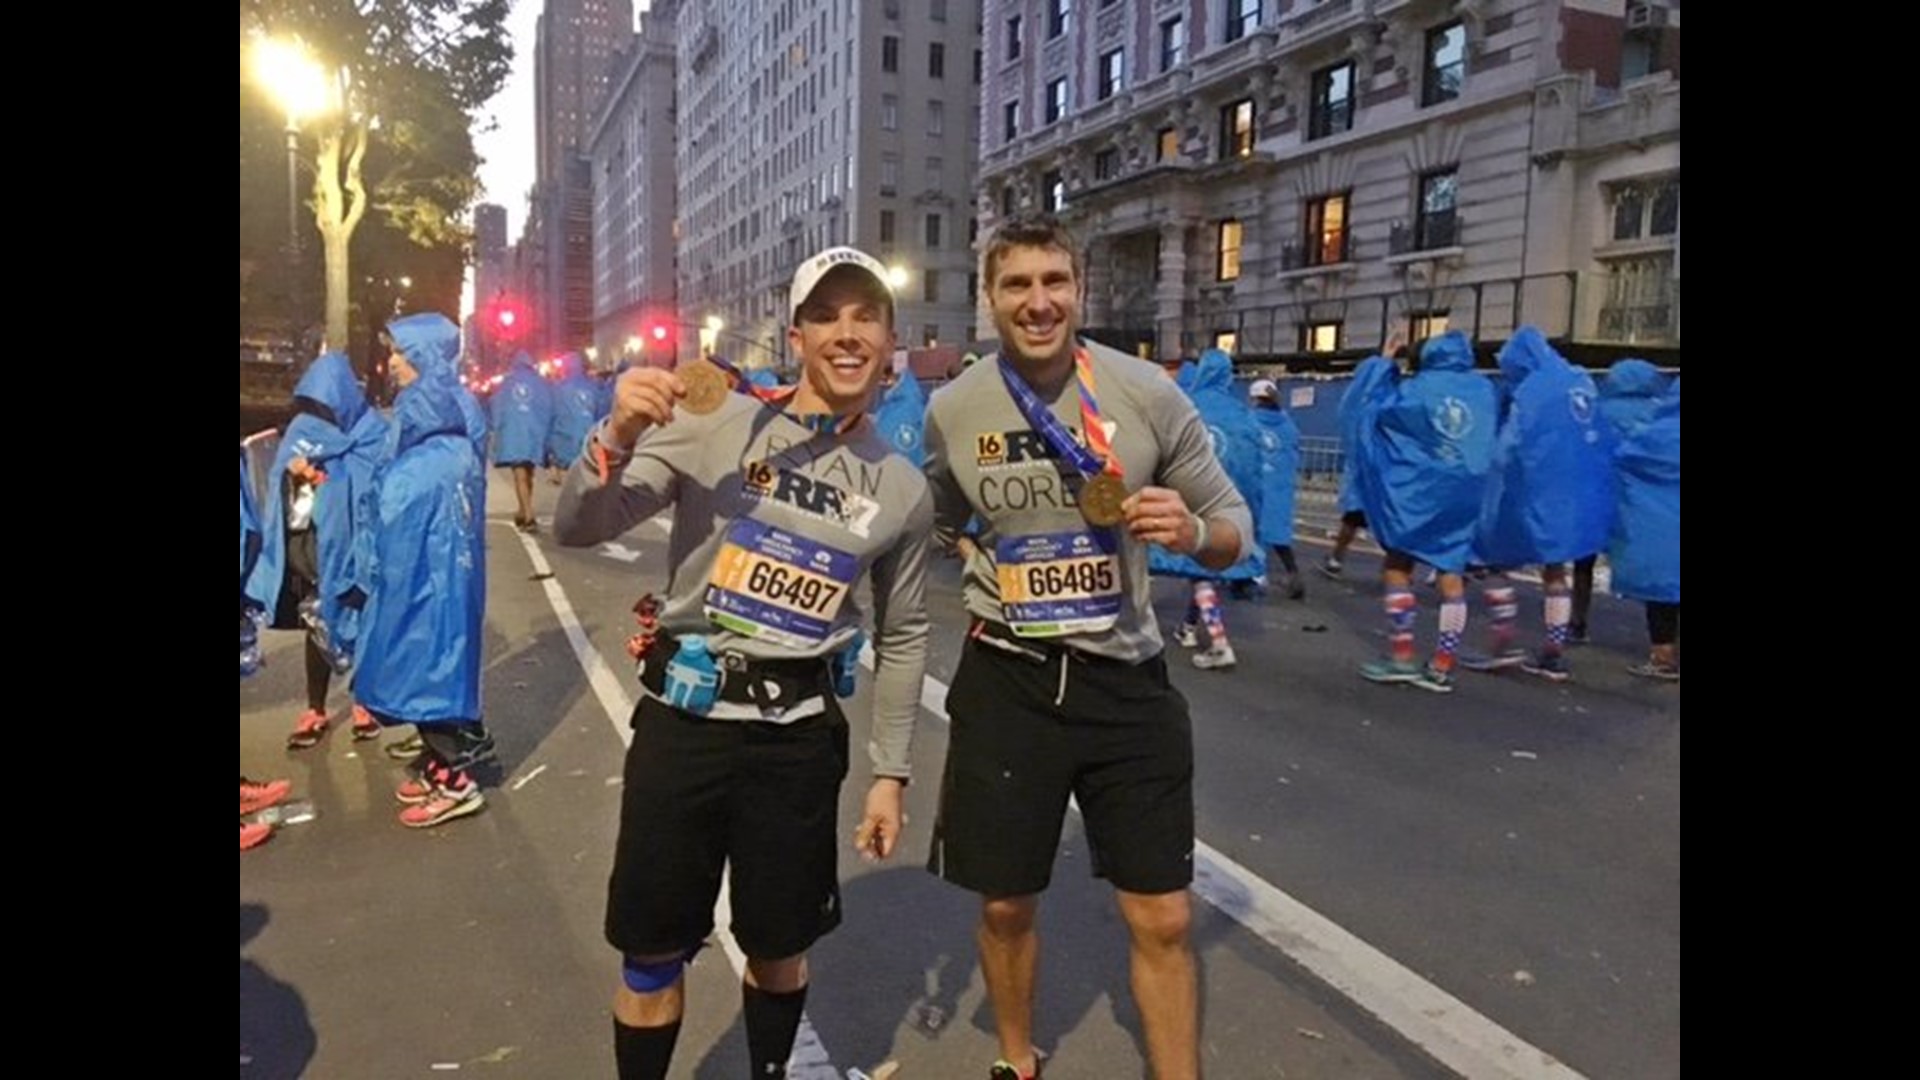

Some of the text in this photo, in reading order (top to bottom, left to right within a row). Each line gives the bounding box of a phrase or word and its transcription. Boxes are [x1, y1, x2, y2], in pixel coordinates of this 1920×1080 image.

[978, 435, 1001, 455] 16
[747, 462, 772, 484] 16
[765, 433, 883, 496] RYAN
[748, 561, 839, 614] 66497
[1028, 560, 1113, 597] 66485
